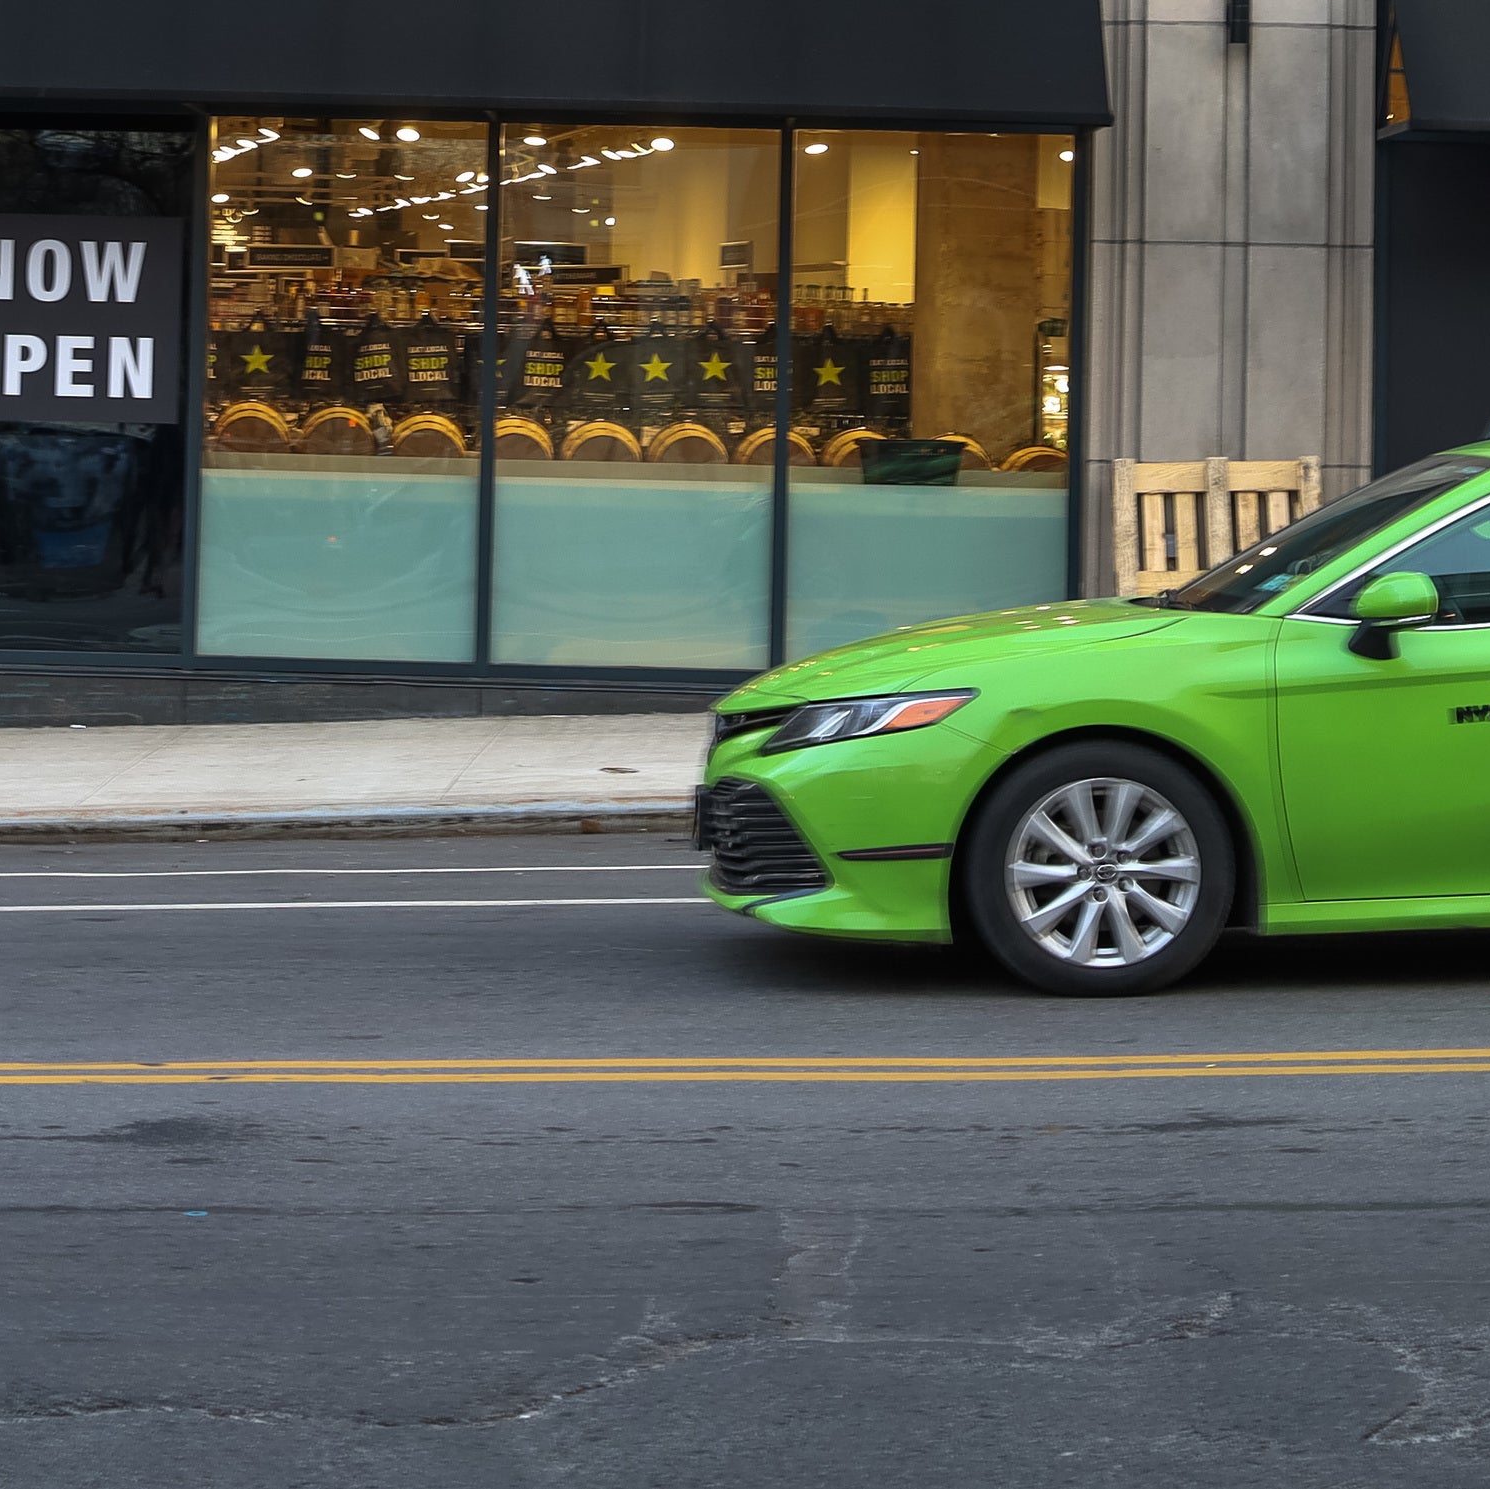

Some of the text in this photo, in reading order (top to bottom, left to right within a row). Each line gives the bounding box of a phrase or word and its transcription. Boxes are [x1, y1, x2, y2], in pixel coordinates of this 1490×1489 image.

[409, 356, 450, 370] SHOP
[524, 362, 565, 376] SHOP
[354, 367, 393, 382] LOCAL
[409, 370, 450, 382] LOCAL
[523, 375, 564, 388] LOCAL
[869, 383, 909, 395] LOCAL
